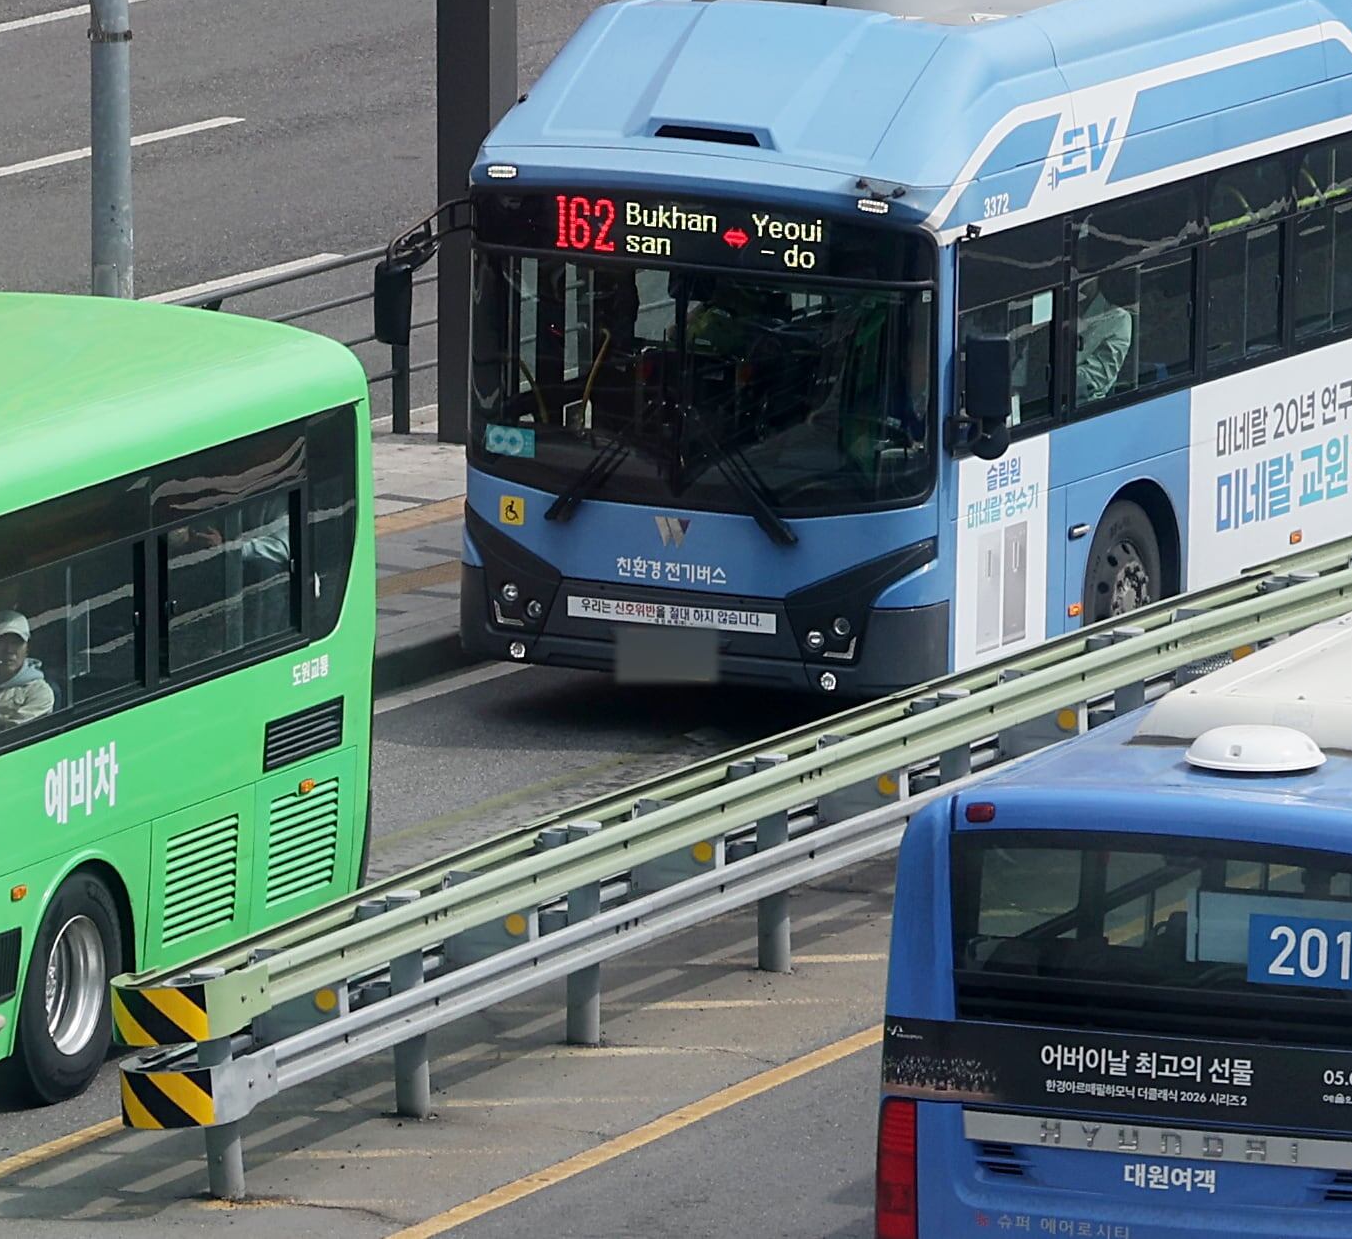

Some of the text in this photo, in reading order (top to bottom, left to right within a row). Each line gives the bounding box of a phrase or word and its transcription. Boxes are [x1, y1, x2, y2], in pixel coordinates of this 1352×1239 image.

[554, 193, 823, 253] 162 Bukhan Yeoui
[983, 193, 1010, 218] 3372
[625, 236, 816, 270] san do
[1215, 405, 1268, 458] 미네랄
[1273, 385, 1316, 441] 20년
[986, 455, 1022, 493] 슬림원
[1215, 451, 1295, 533] 미네랄
[967, 481, 1040, 530] 미네랄 정수기
[616, 555, 728, 585] 친환경 전기버스
[580, 598, 612, 613] 우리는
[614, 601, 666, 619] 신호위반을
[669, 606, 691, 622] 절대
[692, 609, 714, 623] 하지
[44, 740, 119, 825] 예비차
[1267, 925, 1352, 981] 201
[1040, 1044, 1131, 1077] 어버이날
[1135, 1051, 1203, 1082] 최고의
[1207, 1057, 1254, 1087] 선물
[1179, 1090, 1208, 1104] 2026
[1039, 1120, 1298, 1164] HYUNDAI
[1123, 1163, 1217, 1194] 대원여객
[997, 1215, 1031, 1233] 슈퍼
